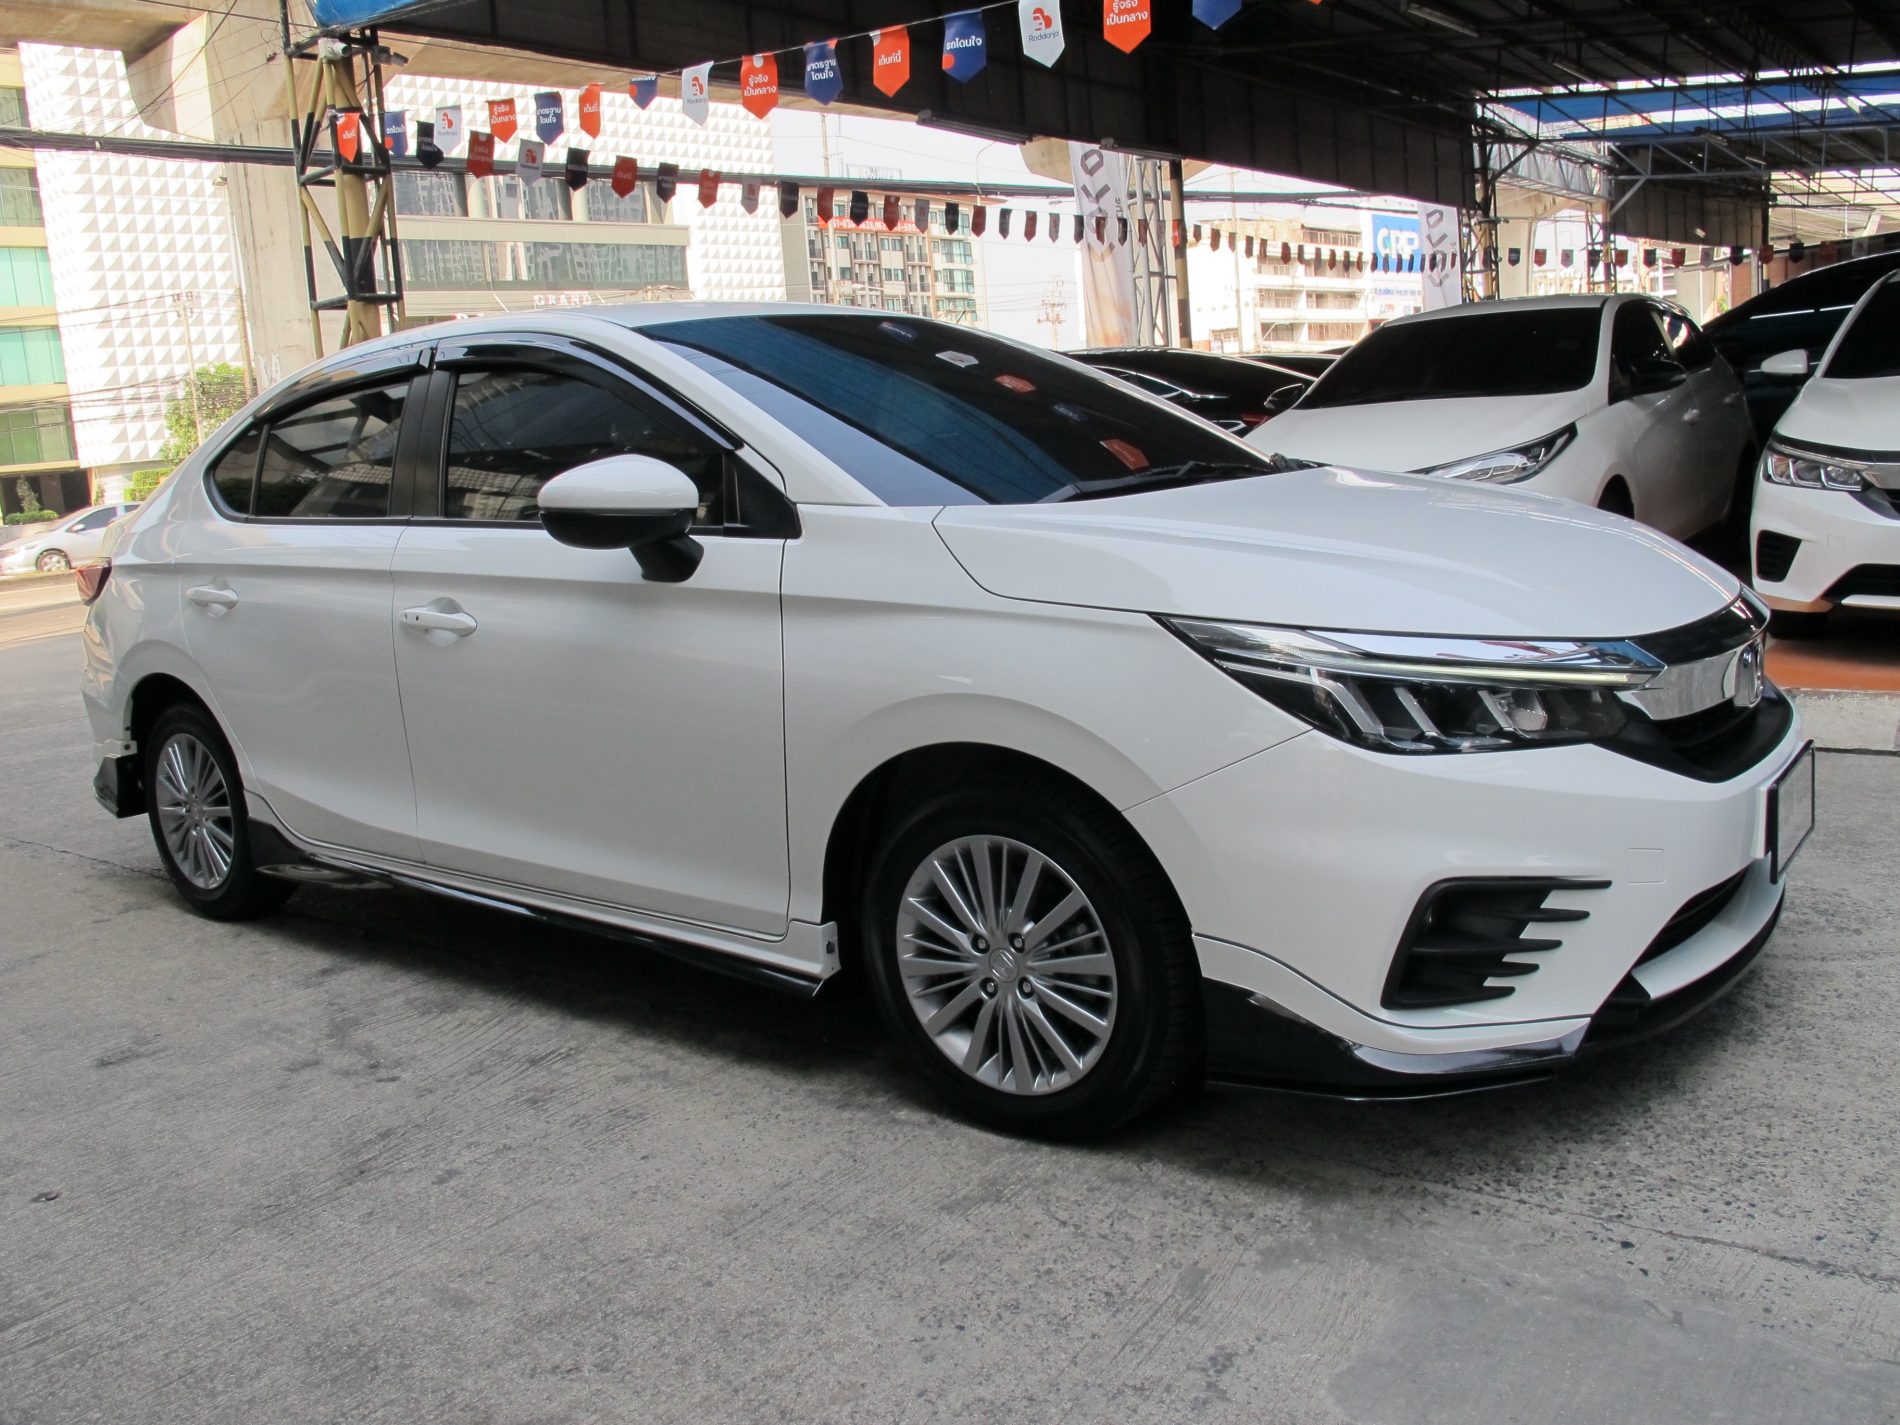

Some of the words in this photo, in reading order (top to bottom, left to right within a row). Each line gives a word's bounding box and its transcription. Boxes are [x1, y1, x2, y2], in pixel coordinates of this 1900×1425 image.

[1106, 11, 1148, 25] เป็นกลาง
[946, 36, 982, 50] รถโดนใจ
[878, 50, 902, 66] เต็นท์นี้
[748, 74, 769, 87] รู้จริง
[811, 69, 834, 81] โดนใจ
[744, 86, 777, 98] เป็นกลาง
[533, 294, 592, 306] GRAND
